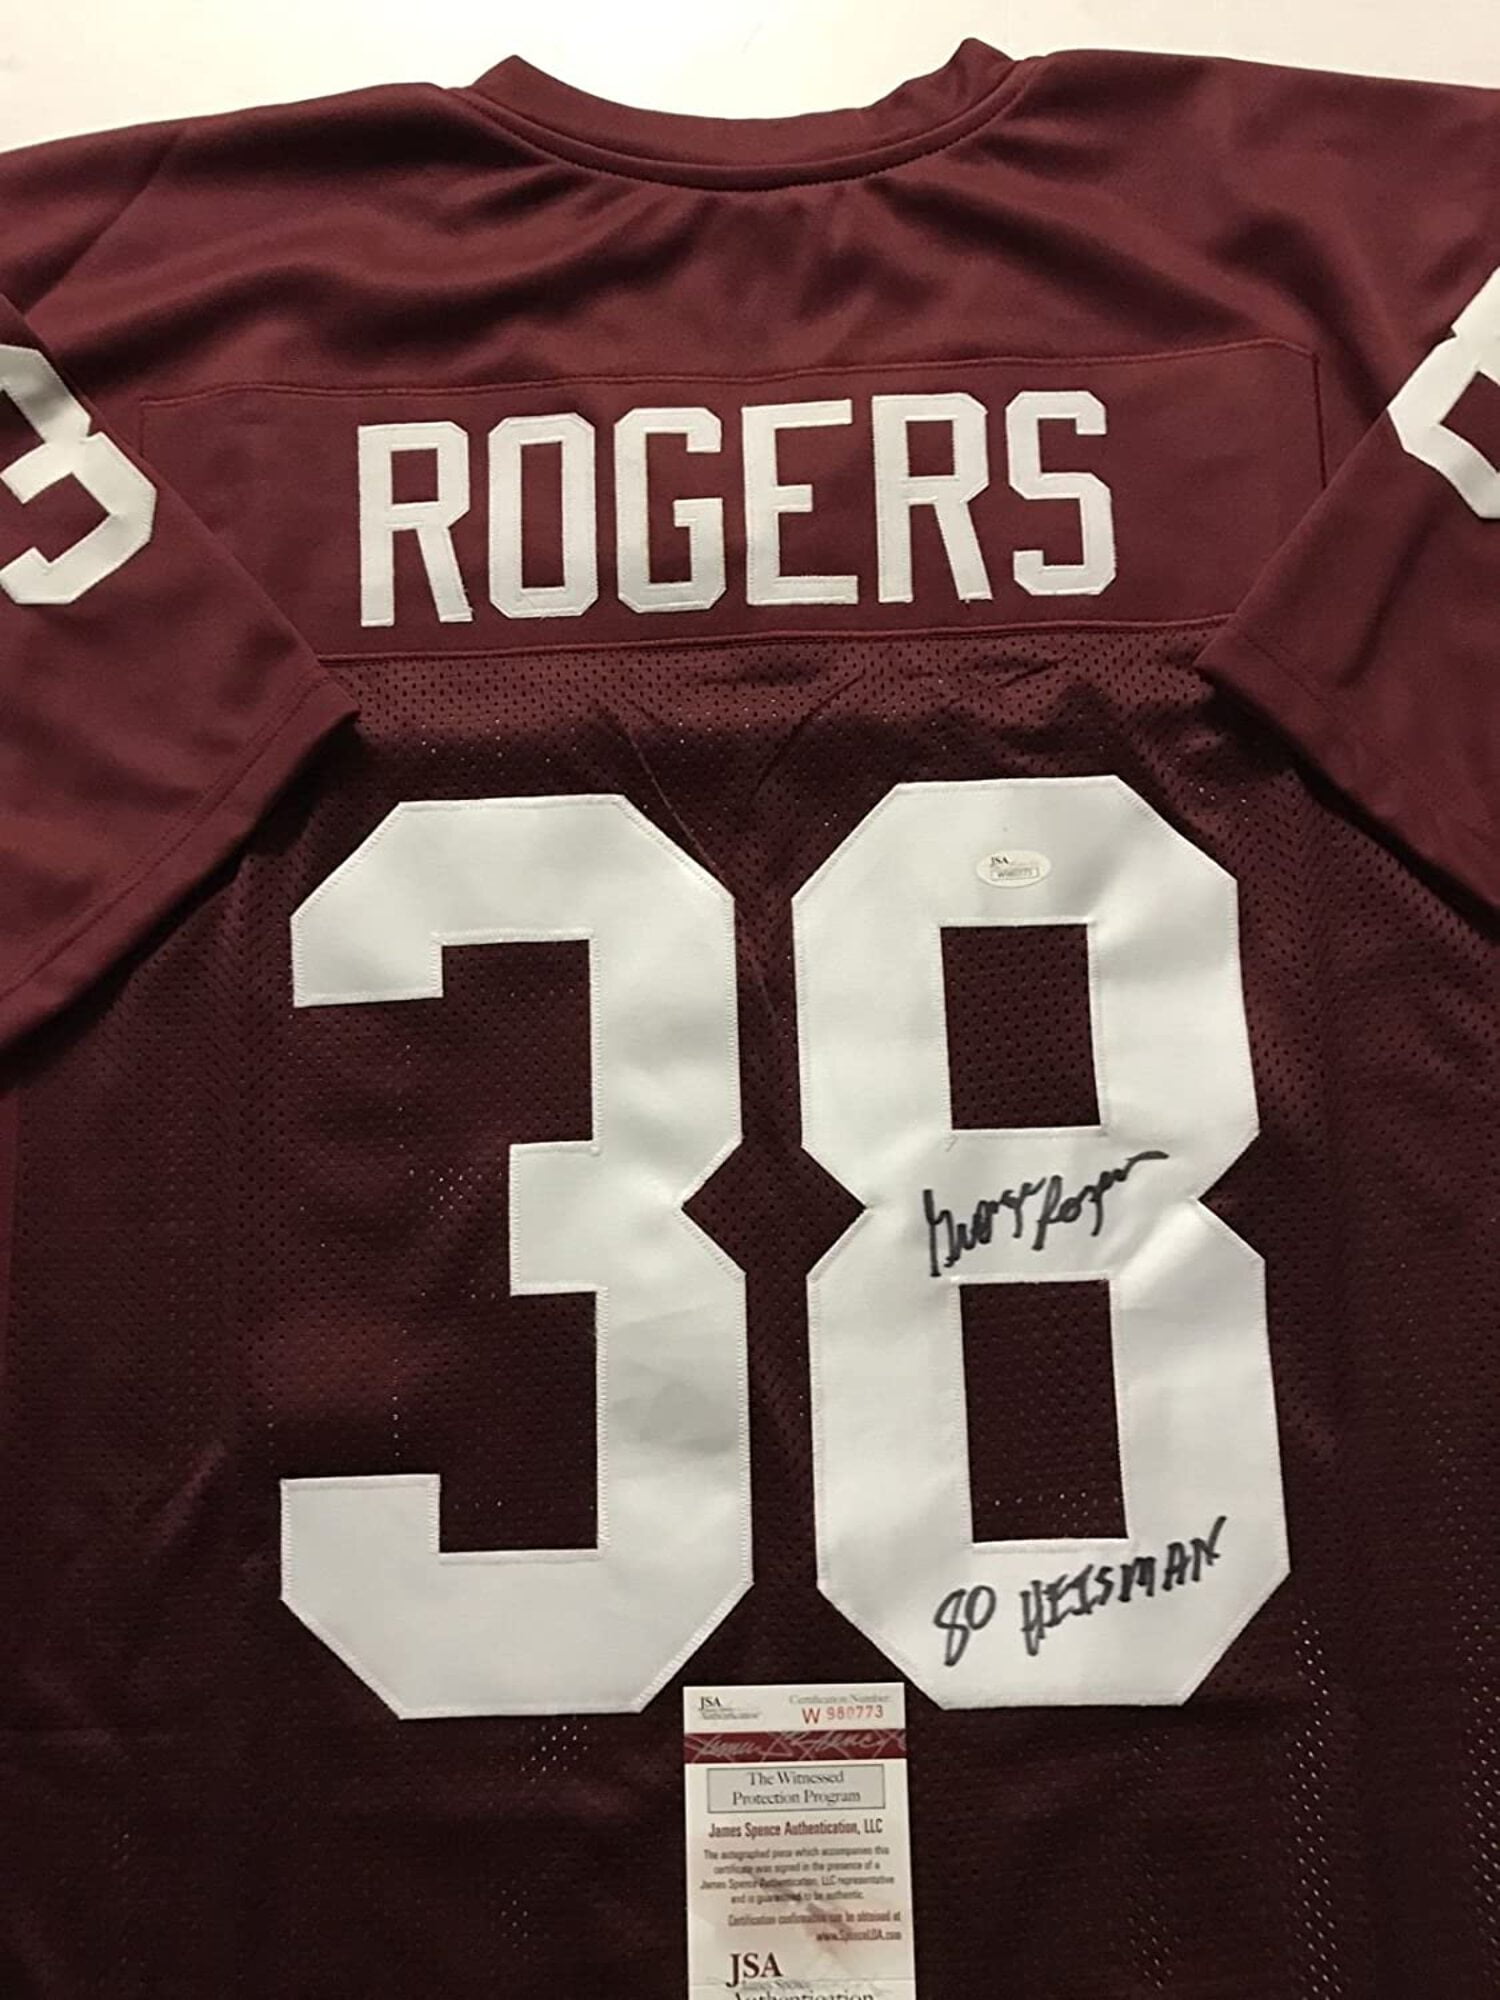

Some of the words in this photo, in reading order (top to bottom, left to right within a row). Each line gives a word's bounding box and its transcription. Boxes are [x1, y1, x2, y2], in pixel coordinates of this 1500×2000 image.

[358, 390, 1118, 627] ROGERS
[279, 775, 1291, 1720] 38
[933, 1585, 997, 1666] 80
[1019, 1515, 1227, 1656] HEISMAN
[698, 1696, 721, 1711] JSA
[802, 1707, 821, 1725] W
[749, 1771, 774, 1786] The
[777, 1770, 844, 1785] Witnessed
[732, 1791, 800, 1806] Protection
[803, 1789, 861, 1806] Program
[708, 1822, 742, 1838] James
[744, 1821, 781, 1840] Spence
[784, 1819, 861, 1837] Authentication,
[864, 1818, 883, 1834] LLC
[725, 1952, 783, 1988] JSA
